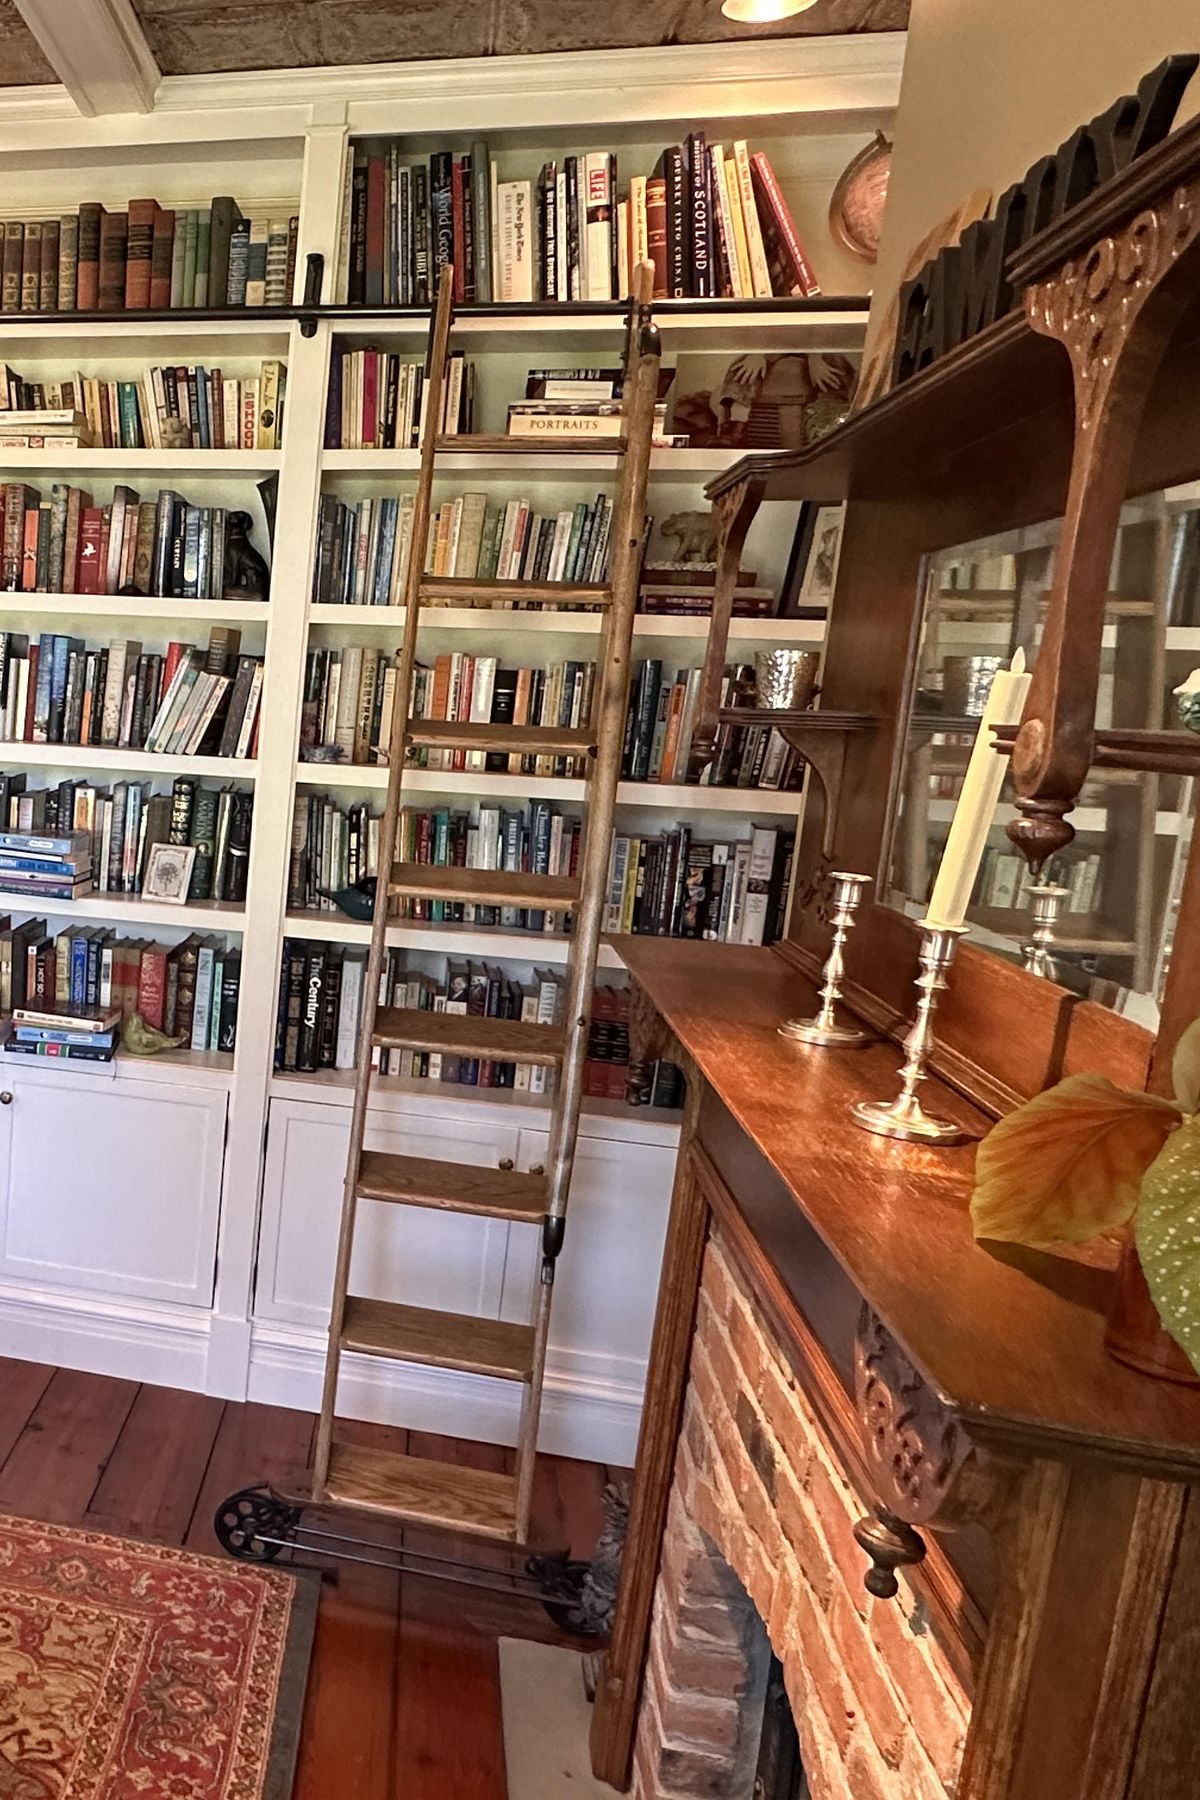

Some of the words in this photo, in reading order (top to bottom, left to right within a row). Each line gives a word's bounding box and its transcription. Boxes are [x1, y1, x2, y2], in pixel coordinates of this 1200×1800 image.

[591, 169, 607, 200] LIFE
[674, 154, 682, 206] JOURNEY
[438, 186, 454, 226] World
[516, 193, 524, 206] The
[547, 191, 555, 204] We
[516, 207, 524, 222] New
[674, 213, 682, 241] INTO
[514, 223, 524, 240] York
[694, 190, 707, 271] SCOTLAND
[416, 251, 428, 283] BIBLE
[516, 241, 524, 262] Times
[674, 247, 682, 283] CHINA
[547, 257, 555, 296] Broadcast
[530, 420, 599, 430] PORTRAITS
[245, 685, 260, 721] Educated
[196, 799, 208, 838] MARTIN
[509, 819, 518, 844] FROZEN
[537, 811, 548, 850] Thunder
[310, 956, 323, 978] The
[304, 977, 322, 1028] Century
